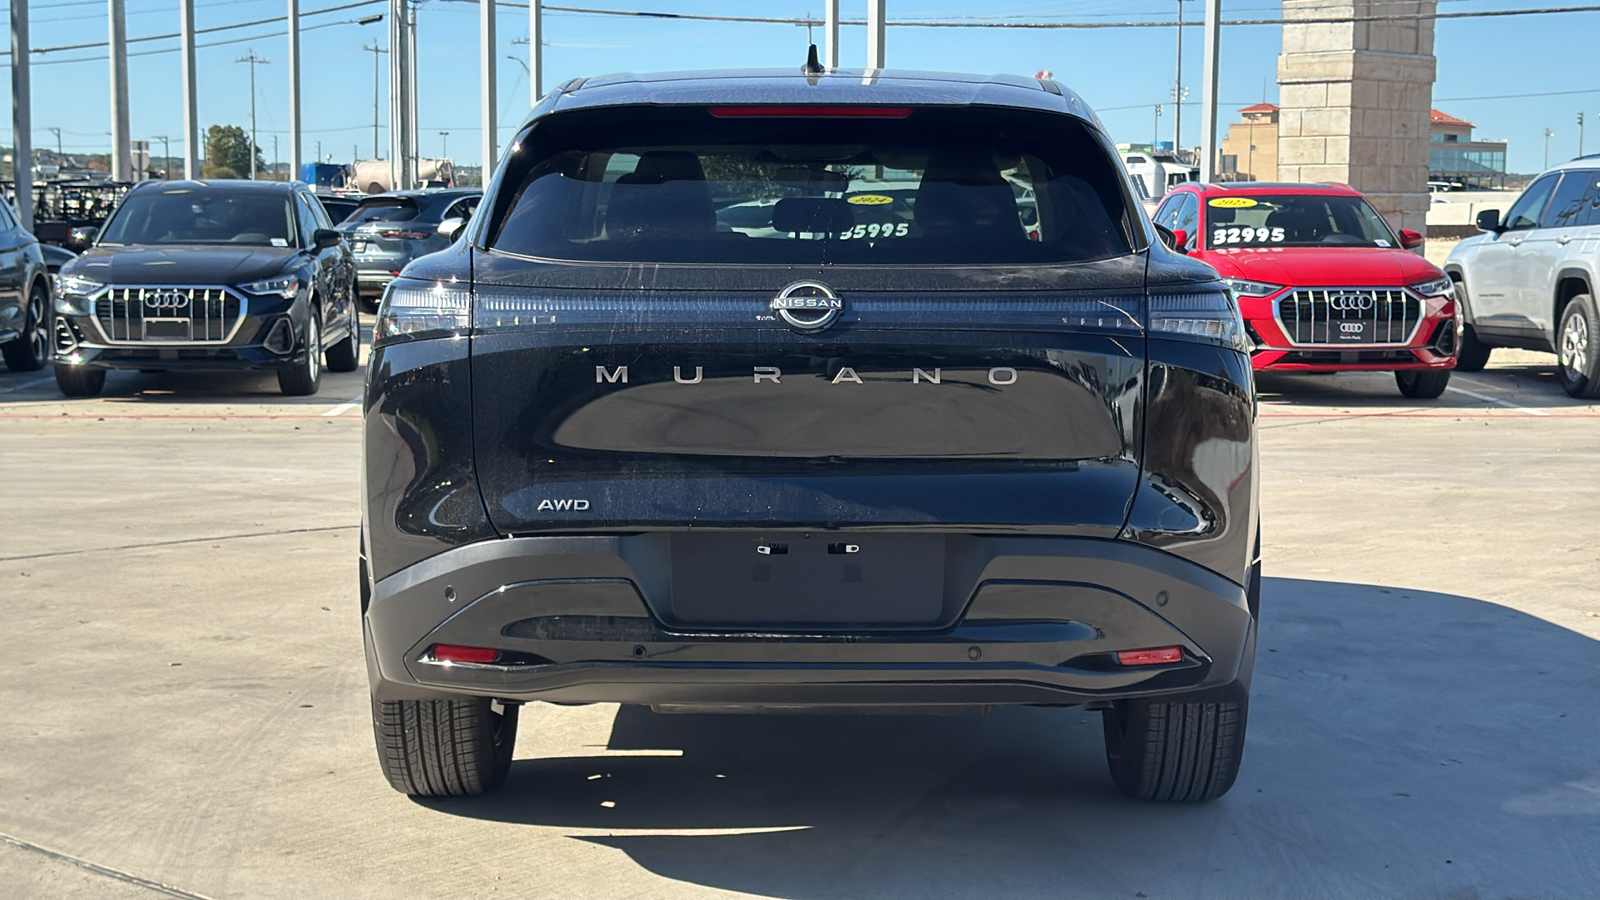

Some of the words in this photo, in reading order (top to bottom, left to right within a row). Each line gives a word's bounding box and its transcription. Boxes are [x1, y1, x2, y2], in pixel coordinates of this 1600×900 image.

[1212, 227, 1285, 245] 32995
[776, 299, 842, 308] NISSAN
[595, 365, 1018, 385] MURANO
[537, 499, 590, 511] AWD
